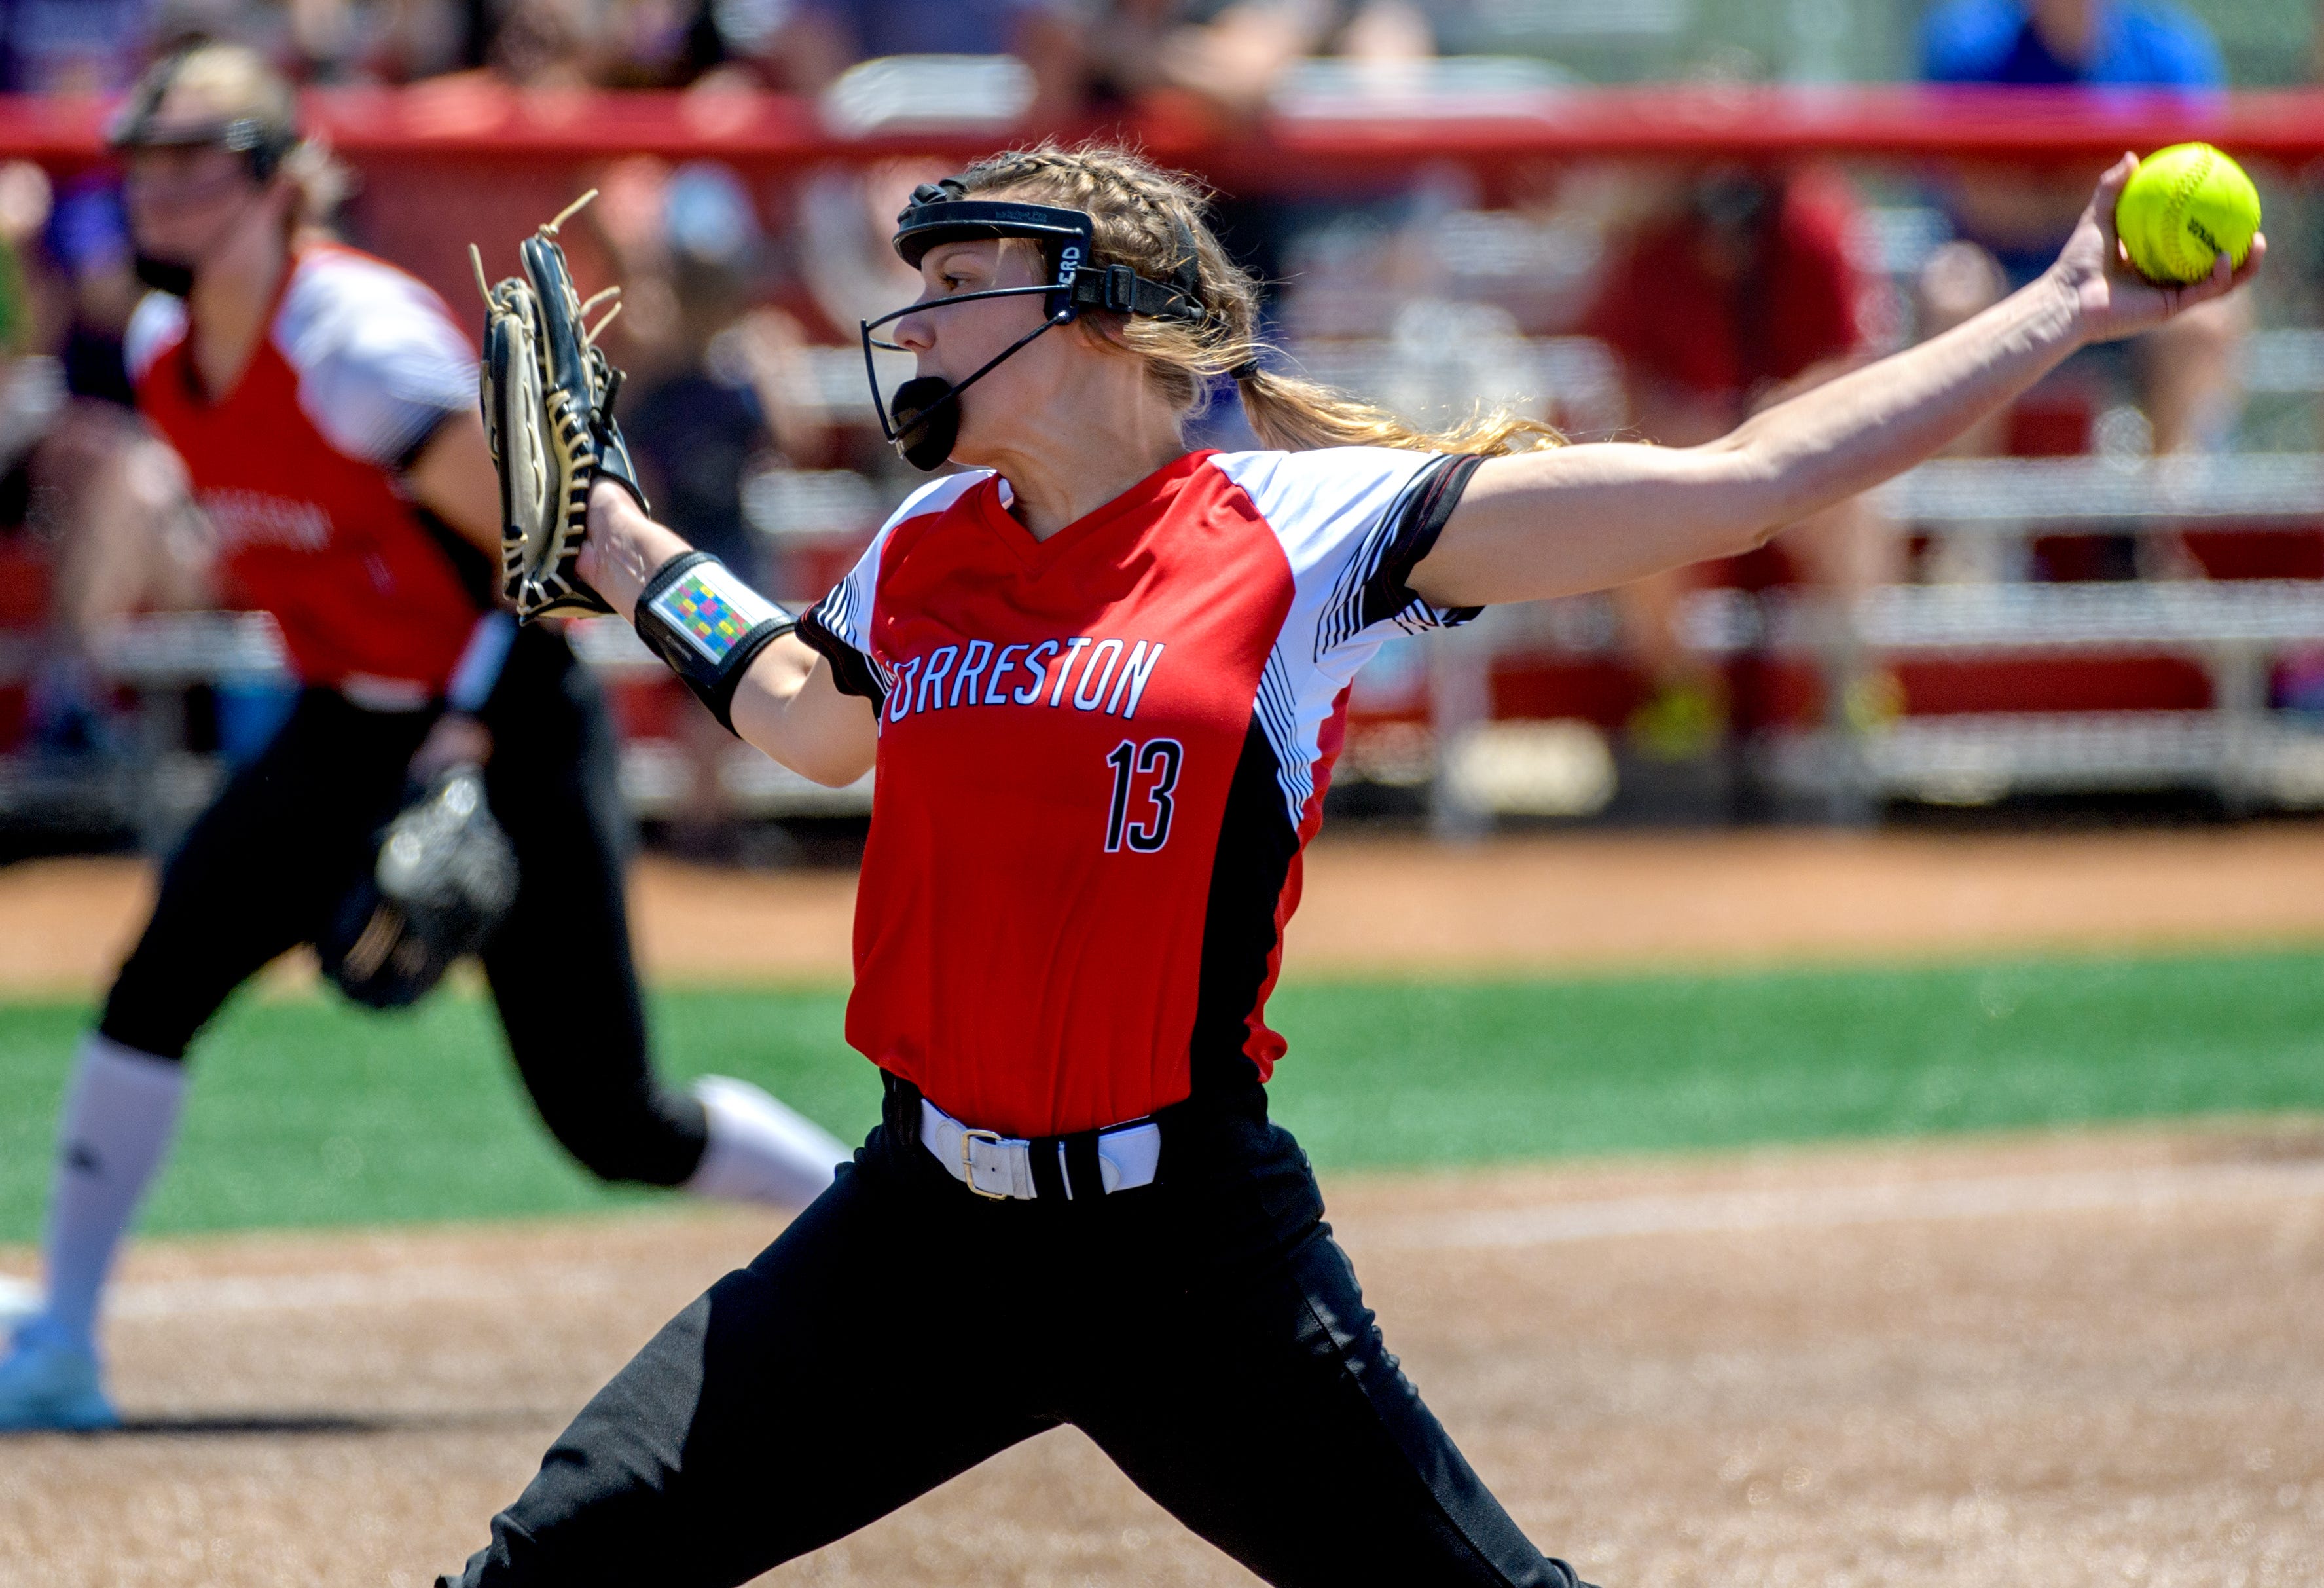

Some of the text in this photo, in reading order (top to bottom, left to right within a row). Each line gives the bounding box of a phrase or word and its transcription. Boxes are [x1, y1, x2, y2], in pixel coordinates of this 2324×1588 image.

[1058, 246, 1080, 284] ERD
[879, 636, 1166, 737] ORRESTON
[1104, 737, 1184, 854] 13
